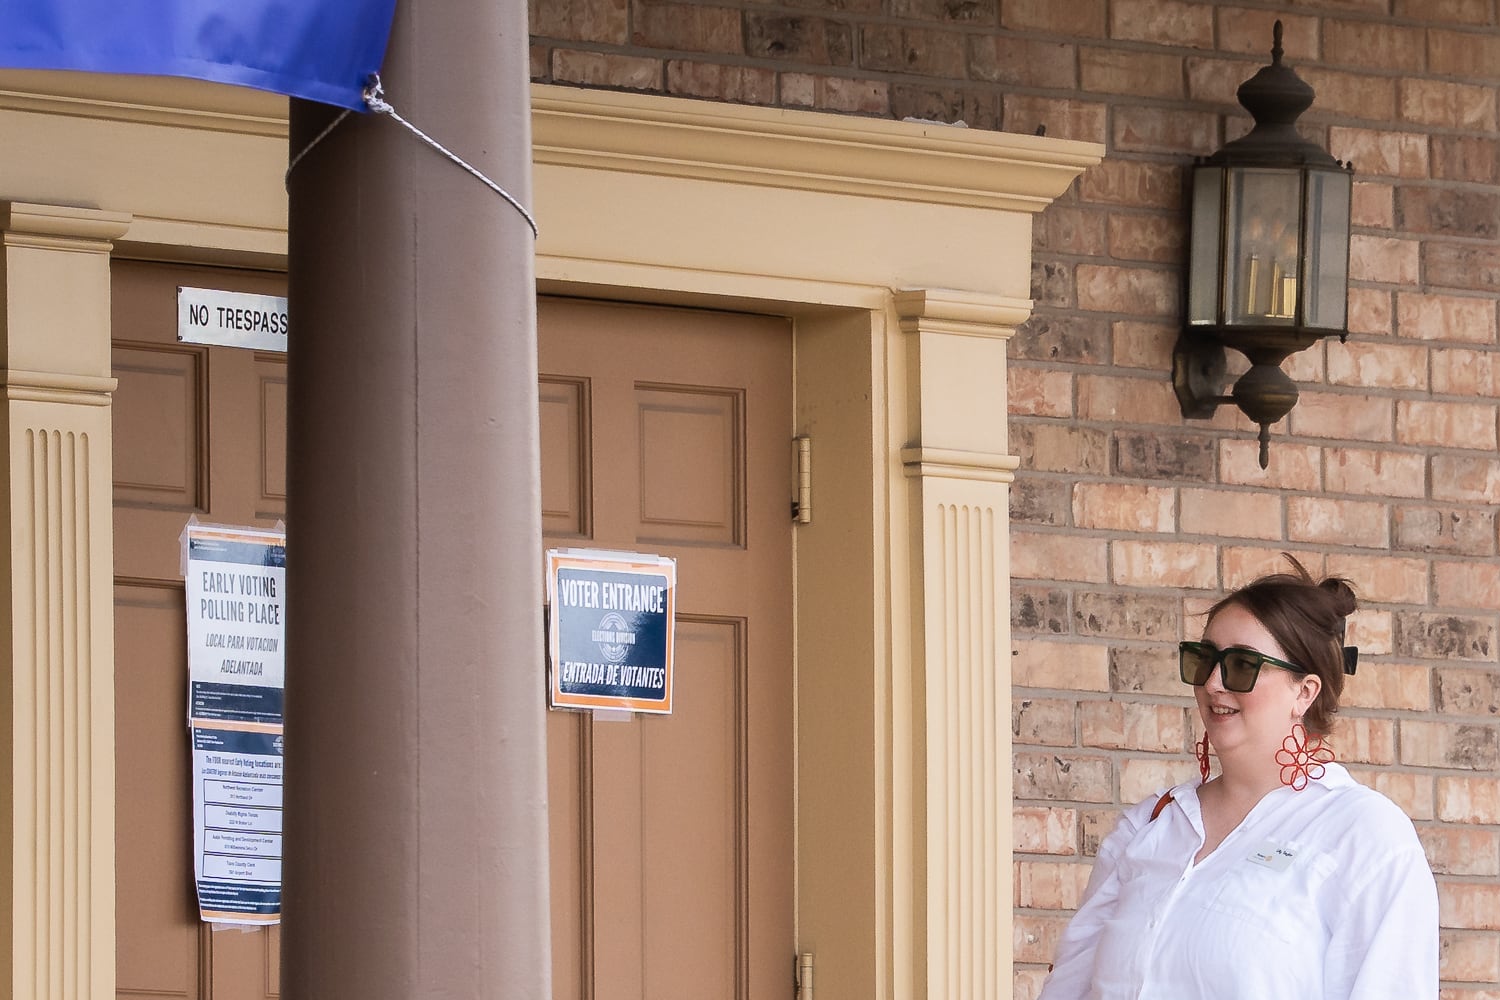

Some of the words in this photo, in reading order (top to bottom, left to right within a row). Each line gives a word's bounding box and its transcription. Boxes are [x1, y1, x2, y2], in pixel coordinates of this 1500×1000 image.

[190, 304, 209, 326] NO
[217, 307, 288, 335] TRESPASS
[202, 571, 235, 594] EARLY
[239, 574, 277, 598] VOTING
[561, 579, 600, 609] VOTER
[602, 582, 664, 614] ENTRANCE
[200, 598, 244, 622] POLLING
[248, 602, 280, 625] PLACE
[205, 633, 226, 648] LOCAL
[227, 635, 244, 650] PARA
[220, 659, 263, 676] ADELANTADA
[563, 661, 605, 684] ENTRADA
[605, 664, 619, 686] DE
[620, 665, 665, 689] VOTANTES
